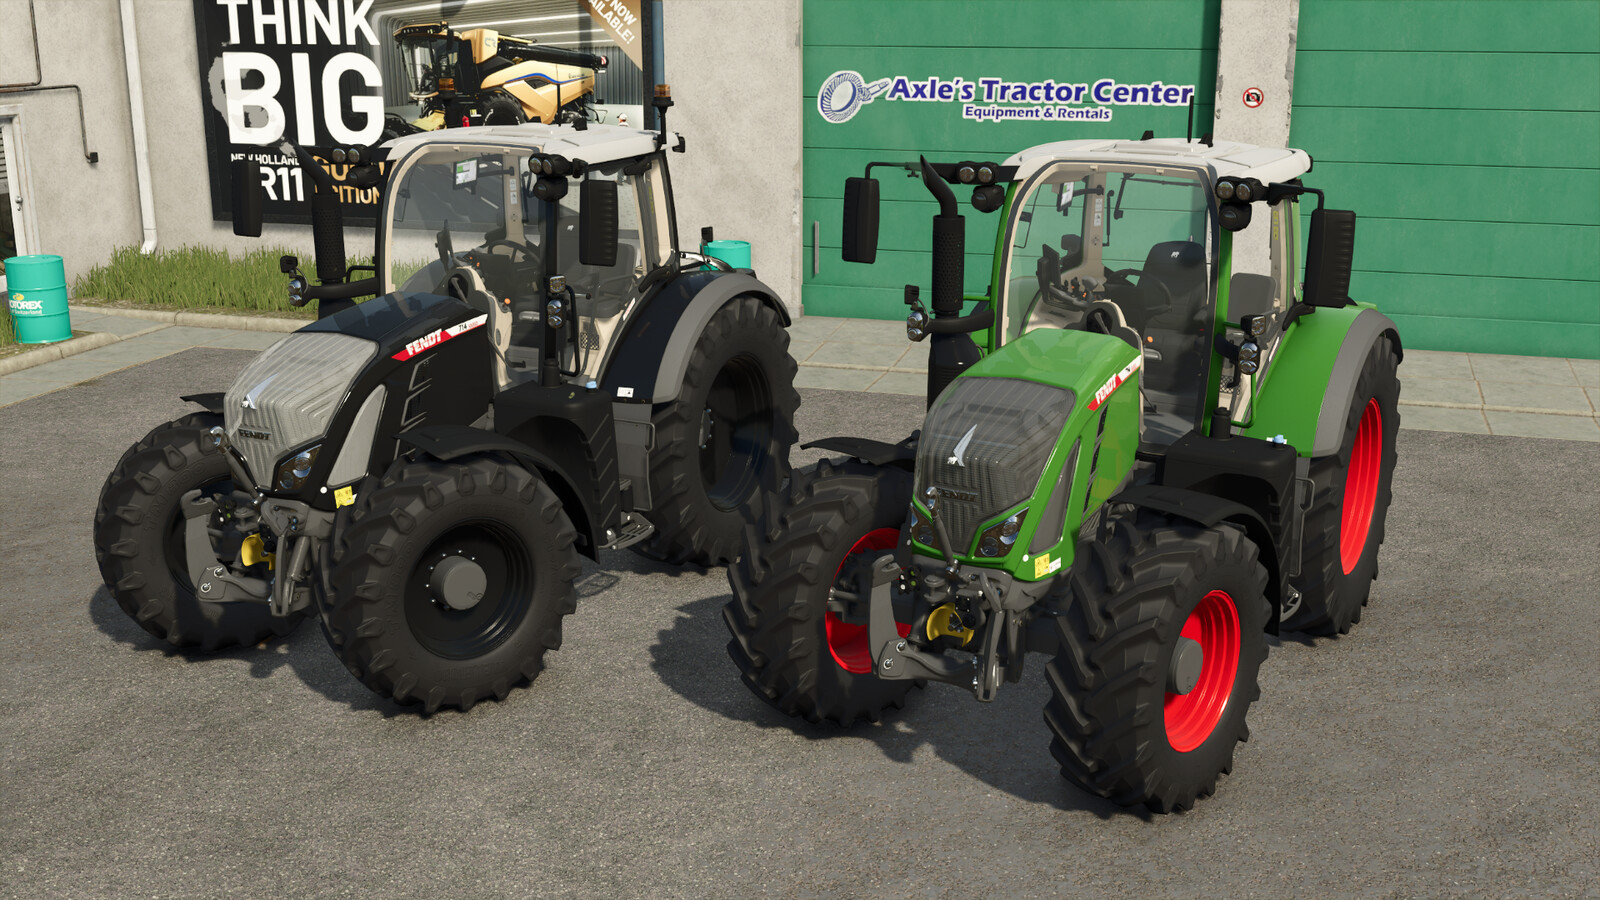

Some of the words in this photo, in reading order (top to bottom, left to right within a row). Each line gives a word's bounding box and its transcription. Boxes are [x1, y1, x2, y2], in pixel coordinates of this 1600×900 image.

[217, 0, 380, 45] THINK
[588, 0, 635, 44] AILABLE!
[609, 0, 637, 26] NOW
[222, 52, 385, 147] BIG
[888, 78, 974, 100] Axle's
[981, 79, 1086, 102] Tractor
[1093, 81, 1193, 104] Center
[965, 106, 1040, 120] Equipment
[1043, 108, 1053, 119] &
[1057, 108, 1110, 120] Rentals
[9, 300, 43, 310] OTOREX
[405, 328, 442, 356] FENDT
